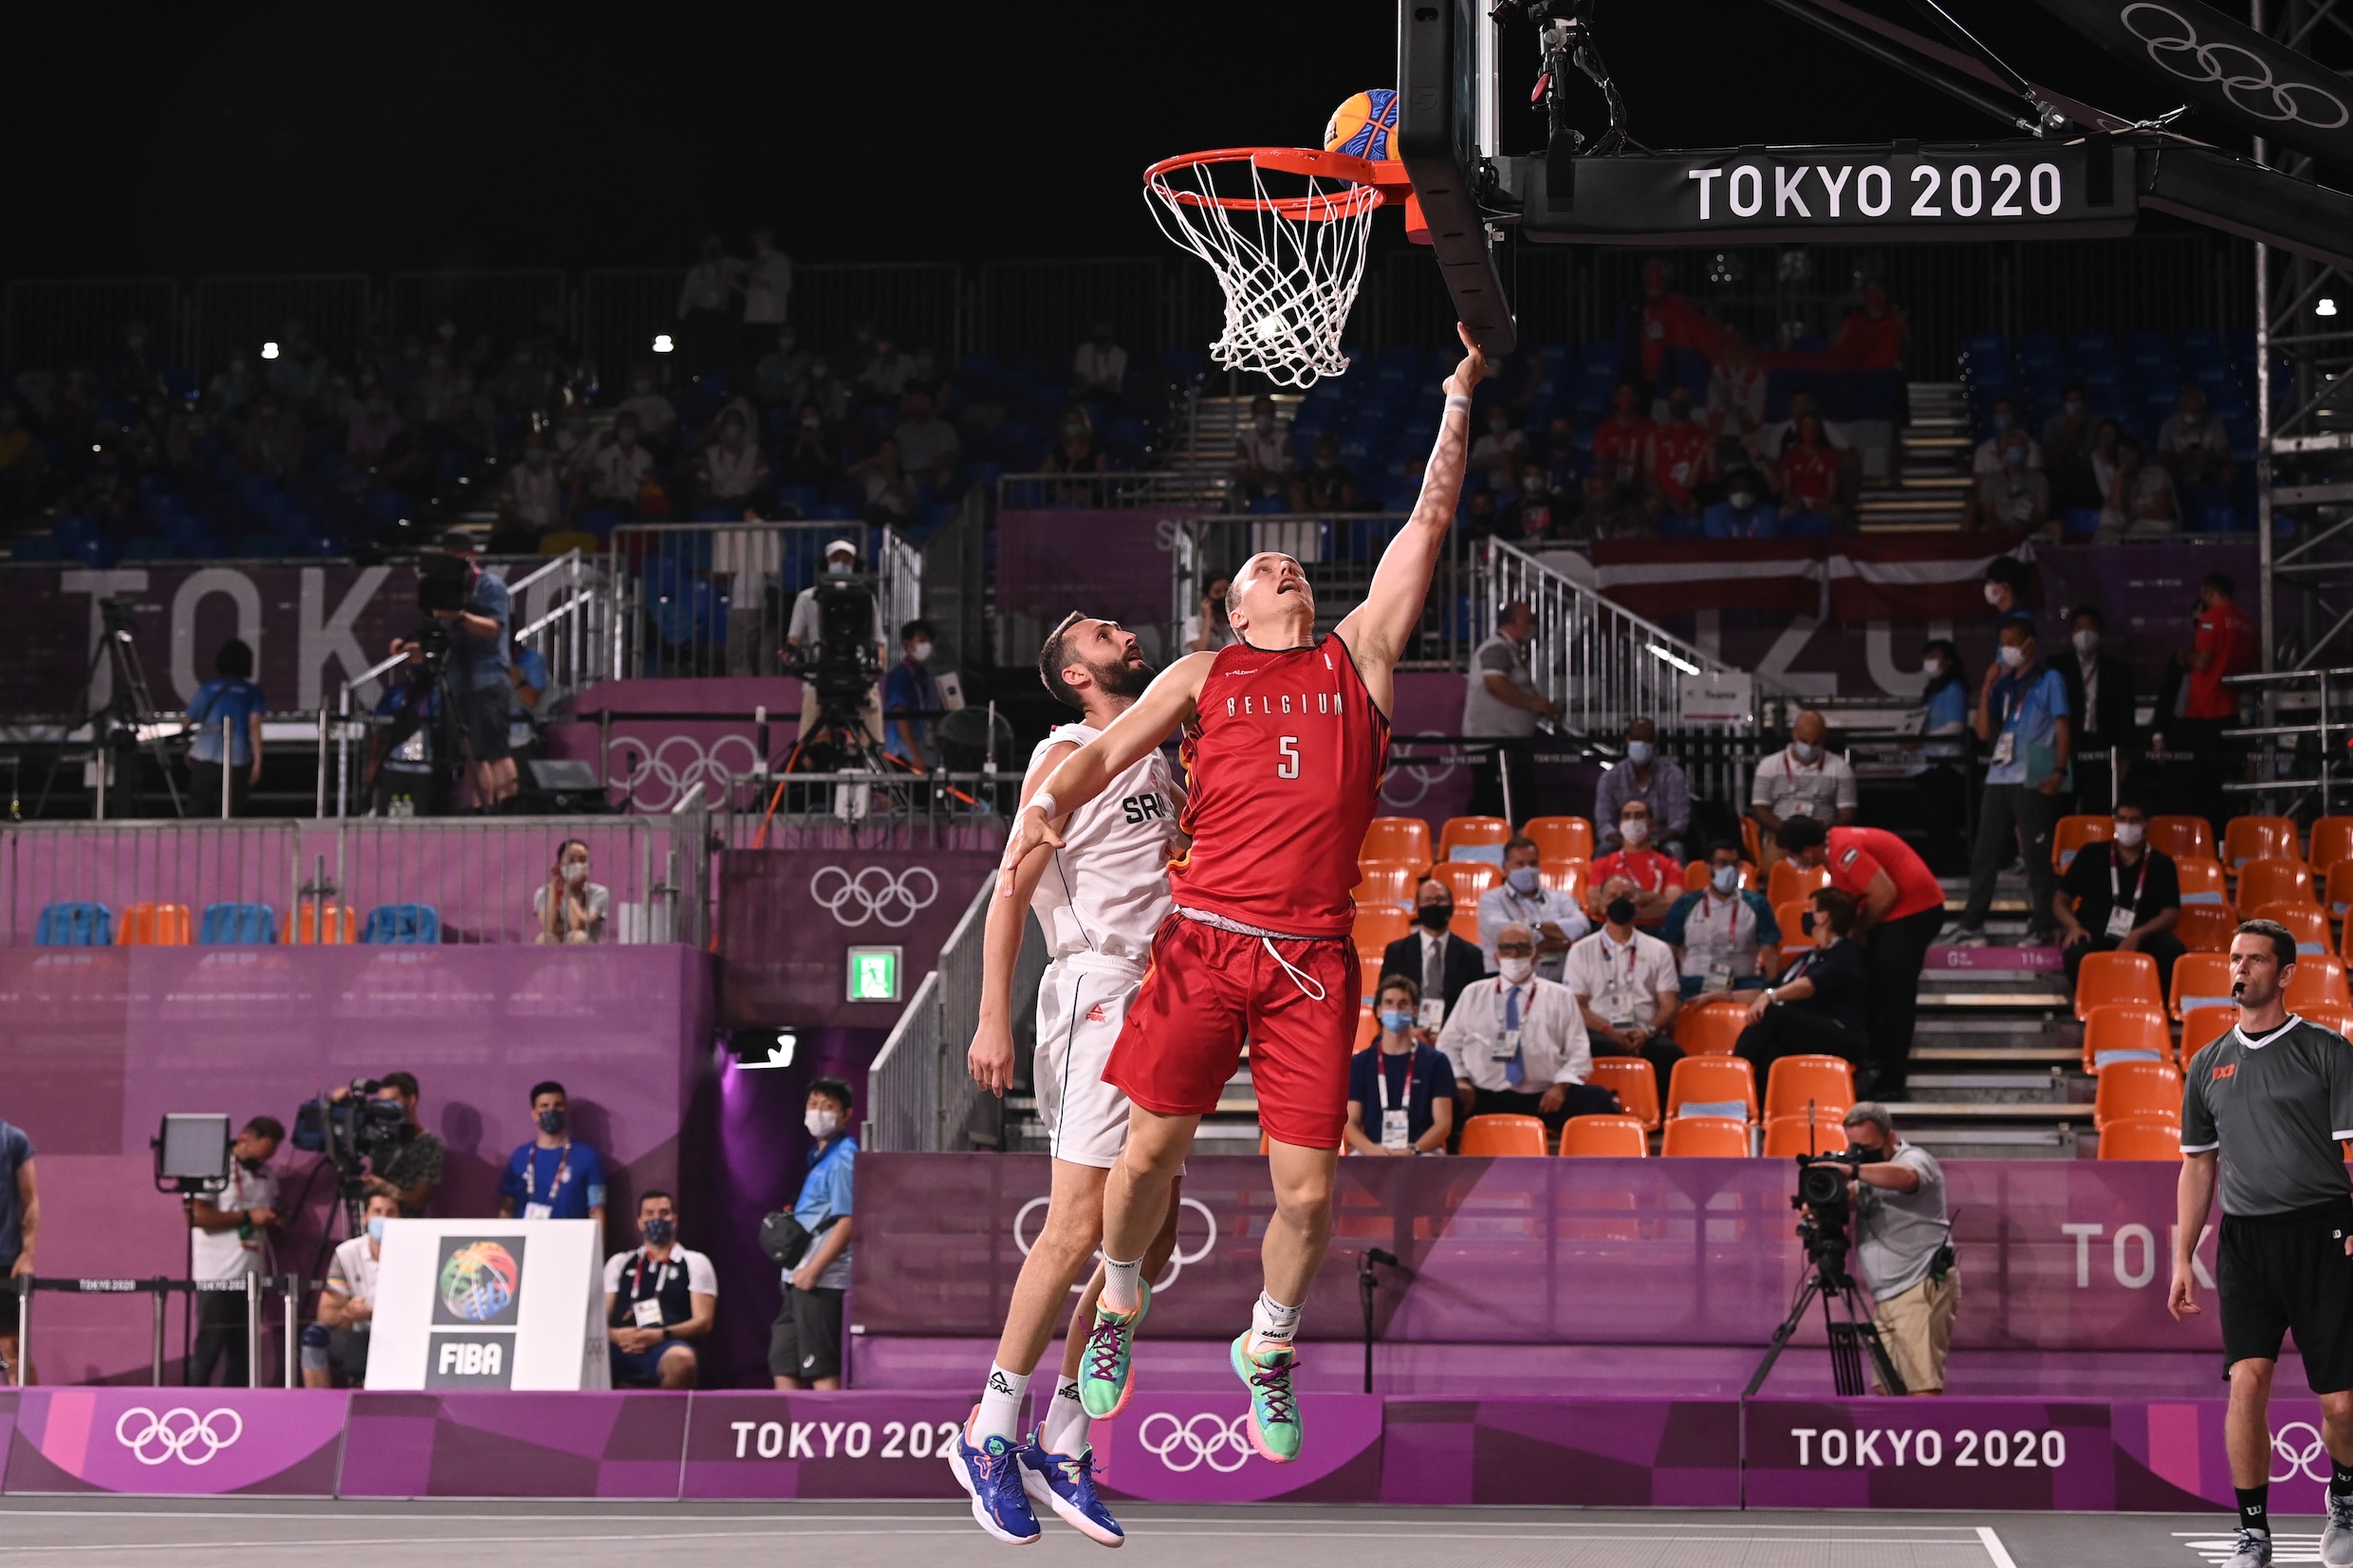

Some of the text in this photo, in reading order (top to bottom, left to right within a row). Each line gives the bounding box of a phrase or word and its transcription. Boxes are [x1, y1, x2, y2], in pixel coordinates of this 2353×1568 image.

[1689, 162, 2062, 220] TOKYO 2020
[1277, 735, 1300, 781] 5
[1085, 1013, 1108, 1024] PEAK
[2061, 1223, 2216, 1289] TOK
[437, 1342, 503, 1375] FIBA
[1058, 1388, 1082, 1403] PEA
[731, 1421, 960, 1459] TOKYO 202
[1790, 1428, 2066, 1467] TOKYO 2020
